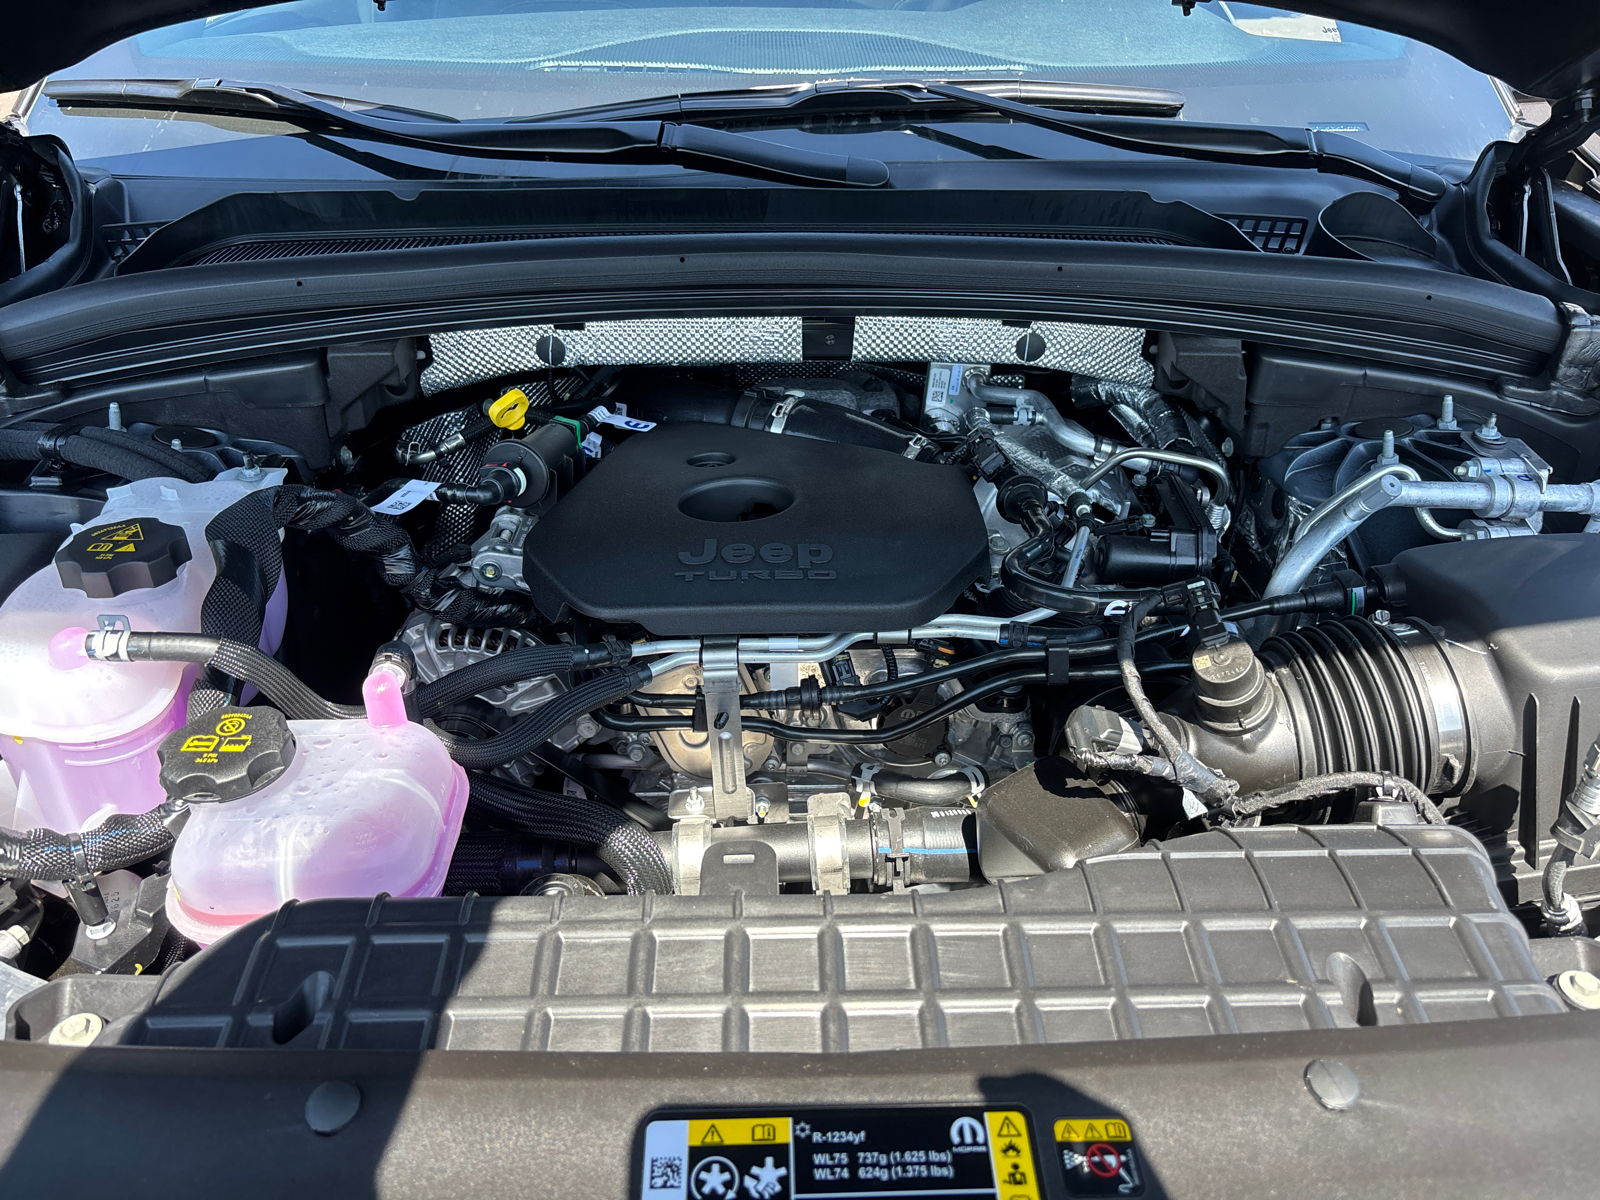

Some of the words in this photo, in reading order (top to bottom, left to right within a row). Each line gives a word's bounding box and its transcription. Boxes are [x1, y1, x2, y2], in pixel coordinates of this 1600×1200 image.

[1322, 26, 1338, 34] Jee
[677, 538, 834, 569] Jeep
[673, 569, 838, 582] TURBO
[812, 1130, 866, 1145] R-1234yf
[813, 1153, 849, 1165] WL75
[857, 1152, 887, 1166] 737g
[890, 1150, 926, 1164] (1.625
[928, 1150, 952, 1162] lbs)
[813, 1167, 849, 1180] WL74
[858, 1167, 889, 1181] 624g
[891, 1165, 927, 1179] (1.375
[930, 1165, 955, 1178] lbs)
